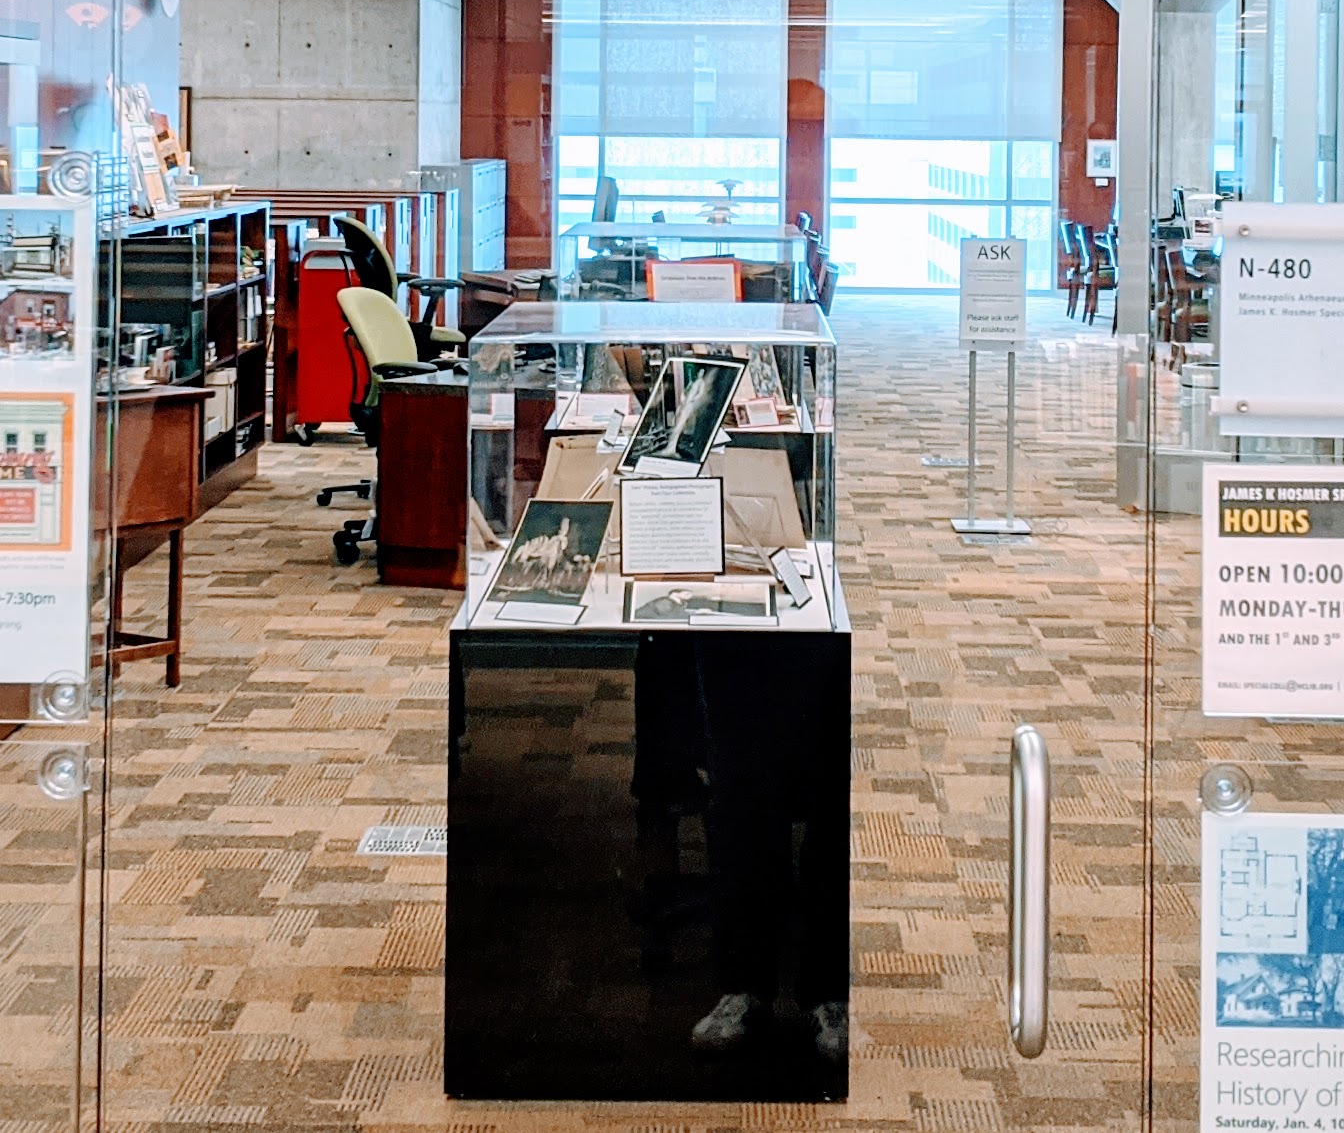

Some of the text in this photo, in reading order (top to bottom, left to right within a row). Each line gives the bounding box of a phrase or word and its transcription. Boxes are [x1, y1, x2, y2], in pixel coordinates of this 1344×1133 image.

[977, 245, 1011, 260] ASK
[1238, 257, 1312, 280] N-480
[1238, 292, 1296, 304] Minneapolis
[967, 314, 989, 322] Please
[1238, 307, 1266, 317] James
[1269, 307, 1278, 317] K.
[1282, 307, 1317, 317] Hosmer
[1221, 487, 1263, 501] JAMES
[1265, 487, 1274, 501] K
[1277, 487, 1330, 502] HOSMER
[1223, 508, 1312, 534] HOURS
[1219, 565, 1271, 584] OPEN
[1282, 564, 1343, 584] 10:00
[1218, 633, 1245, 645] AND
[1249, 634, 1270, 645] THE
[1292, 634, 1320, 646] AND
[1216, 1081, 1307, 1113] History
[1315, 1081, 1342, 1107] of
[1215, 1116, 1279, 1131] Saturday,
[1283, 1117, 1310, 1130] Jan.
[1314, 1118, 1326, 1132] 4,
